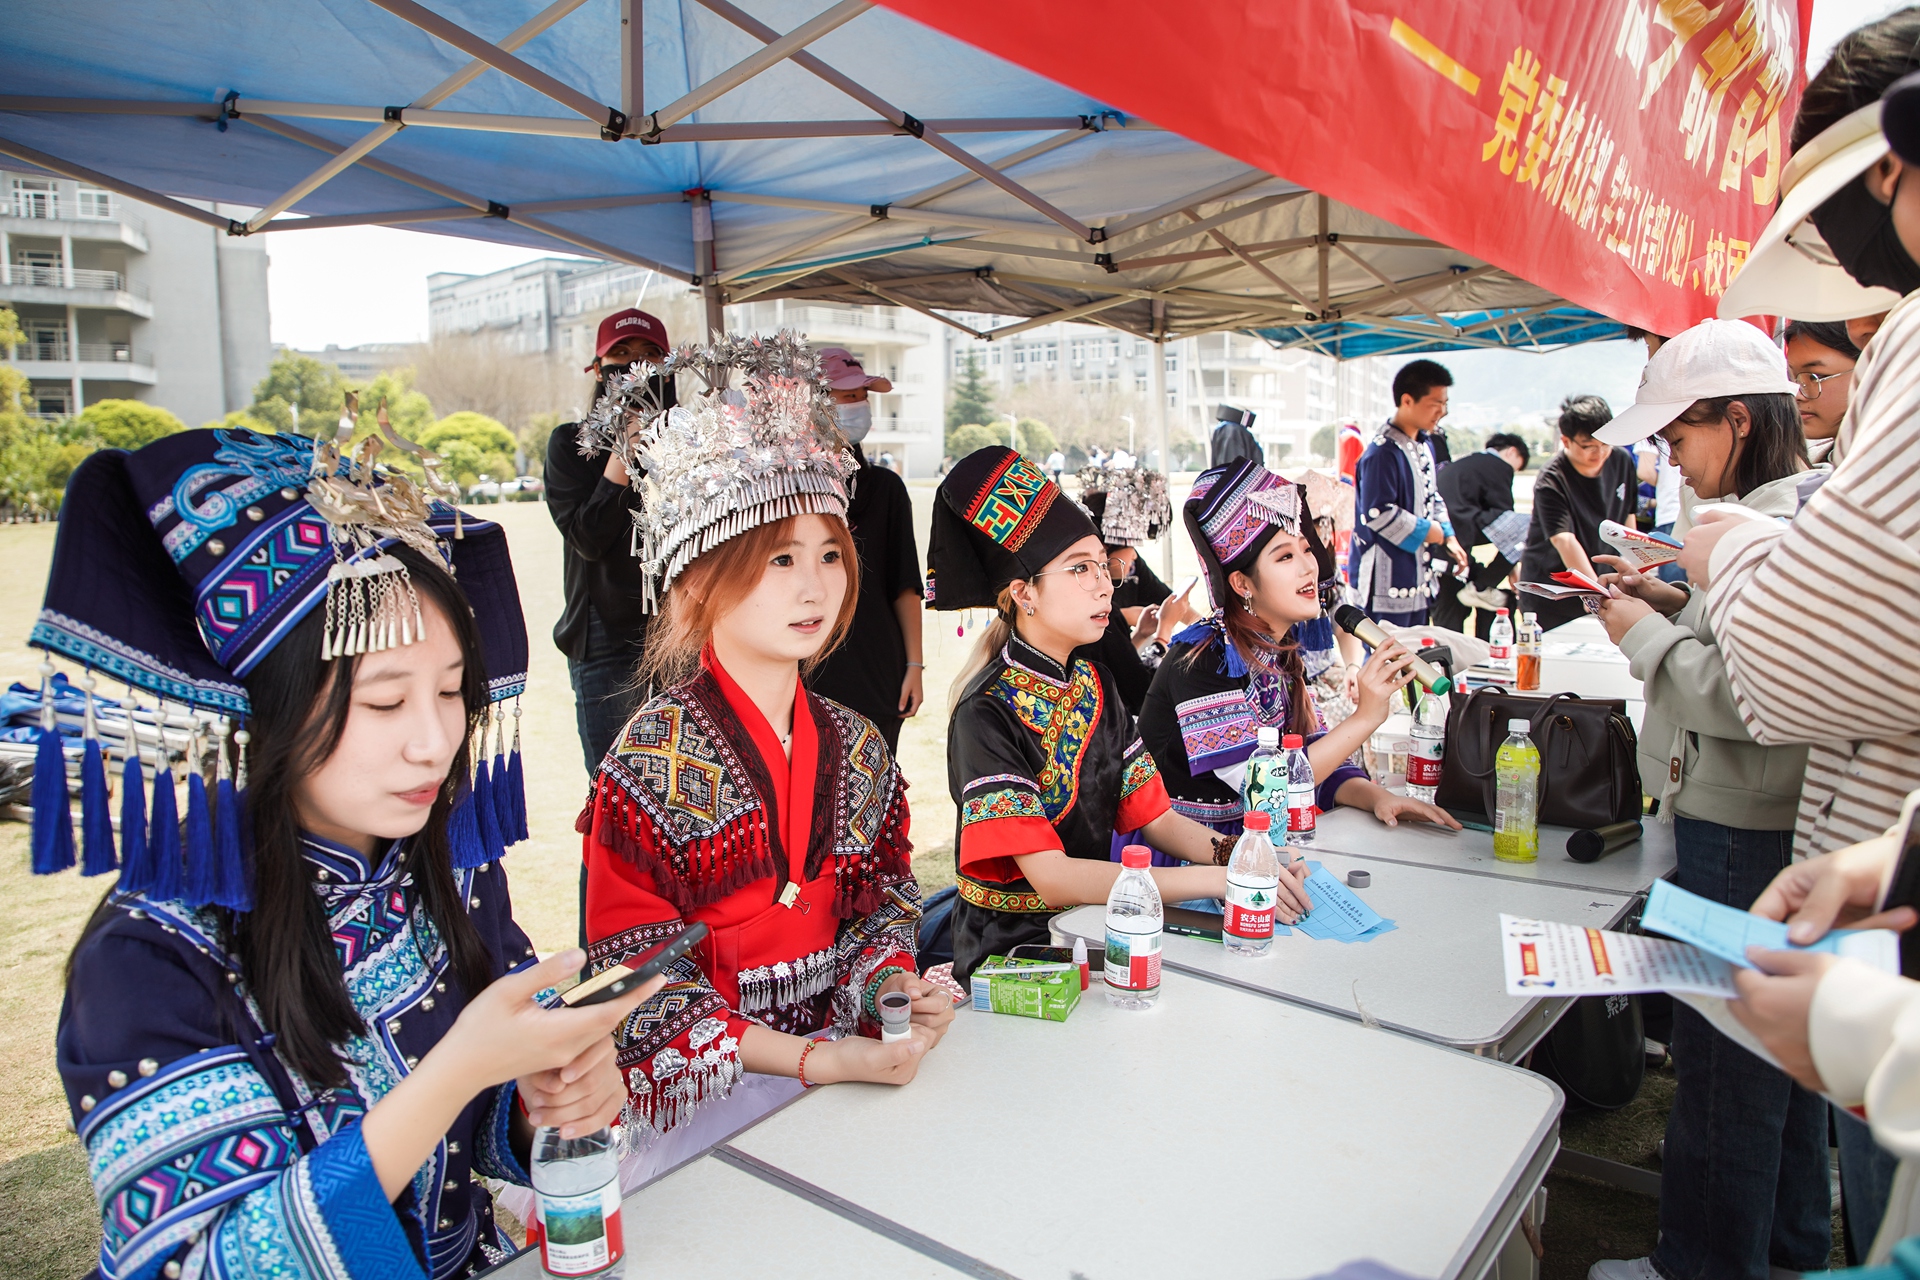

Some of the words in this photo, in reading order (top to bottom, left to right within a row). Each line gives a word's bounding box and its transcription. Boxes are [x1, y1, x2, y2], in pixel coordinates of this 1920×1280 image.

[615, 317, 651, 329] COLORADO
[1240, 913, 1271, 922] 农夫山泉
